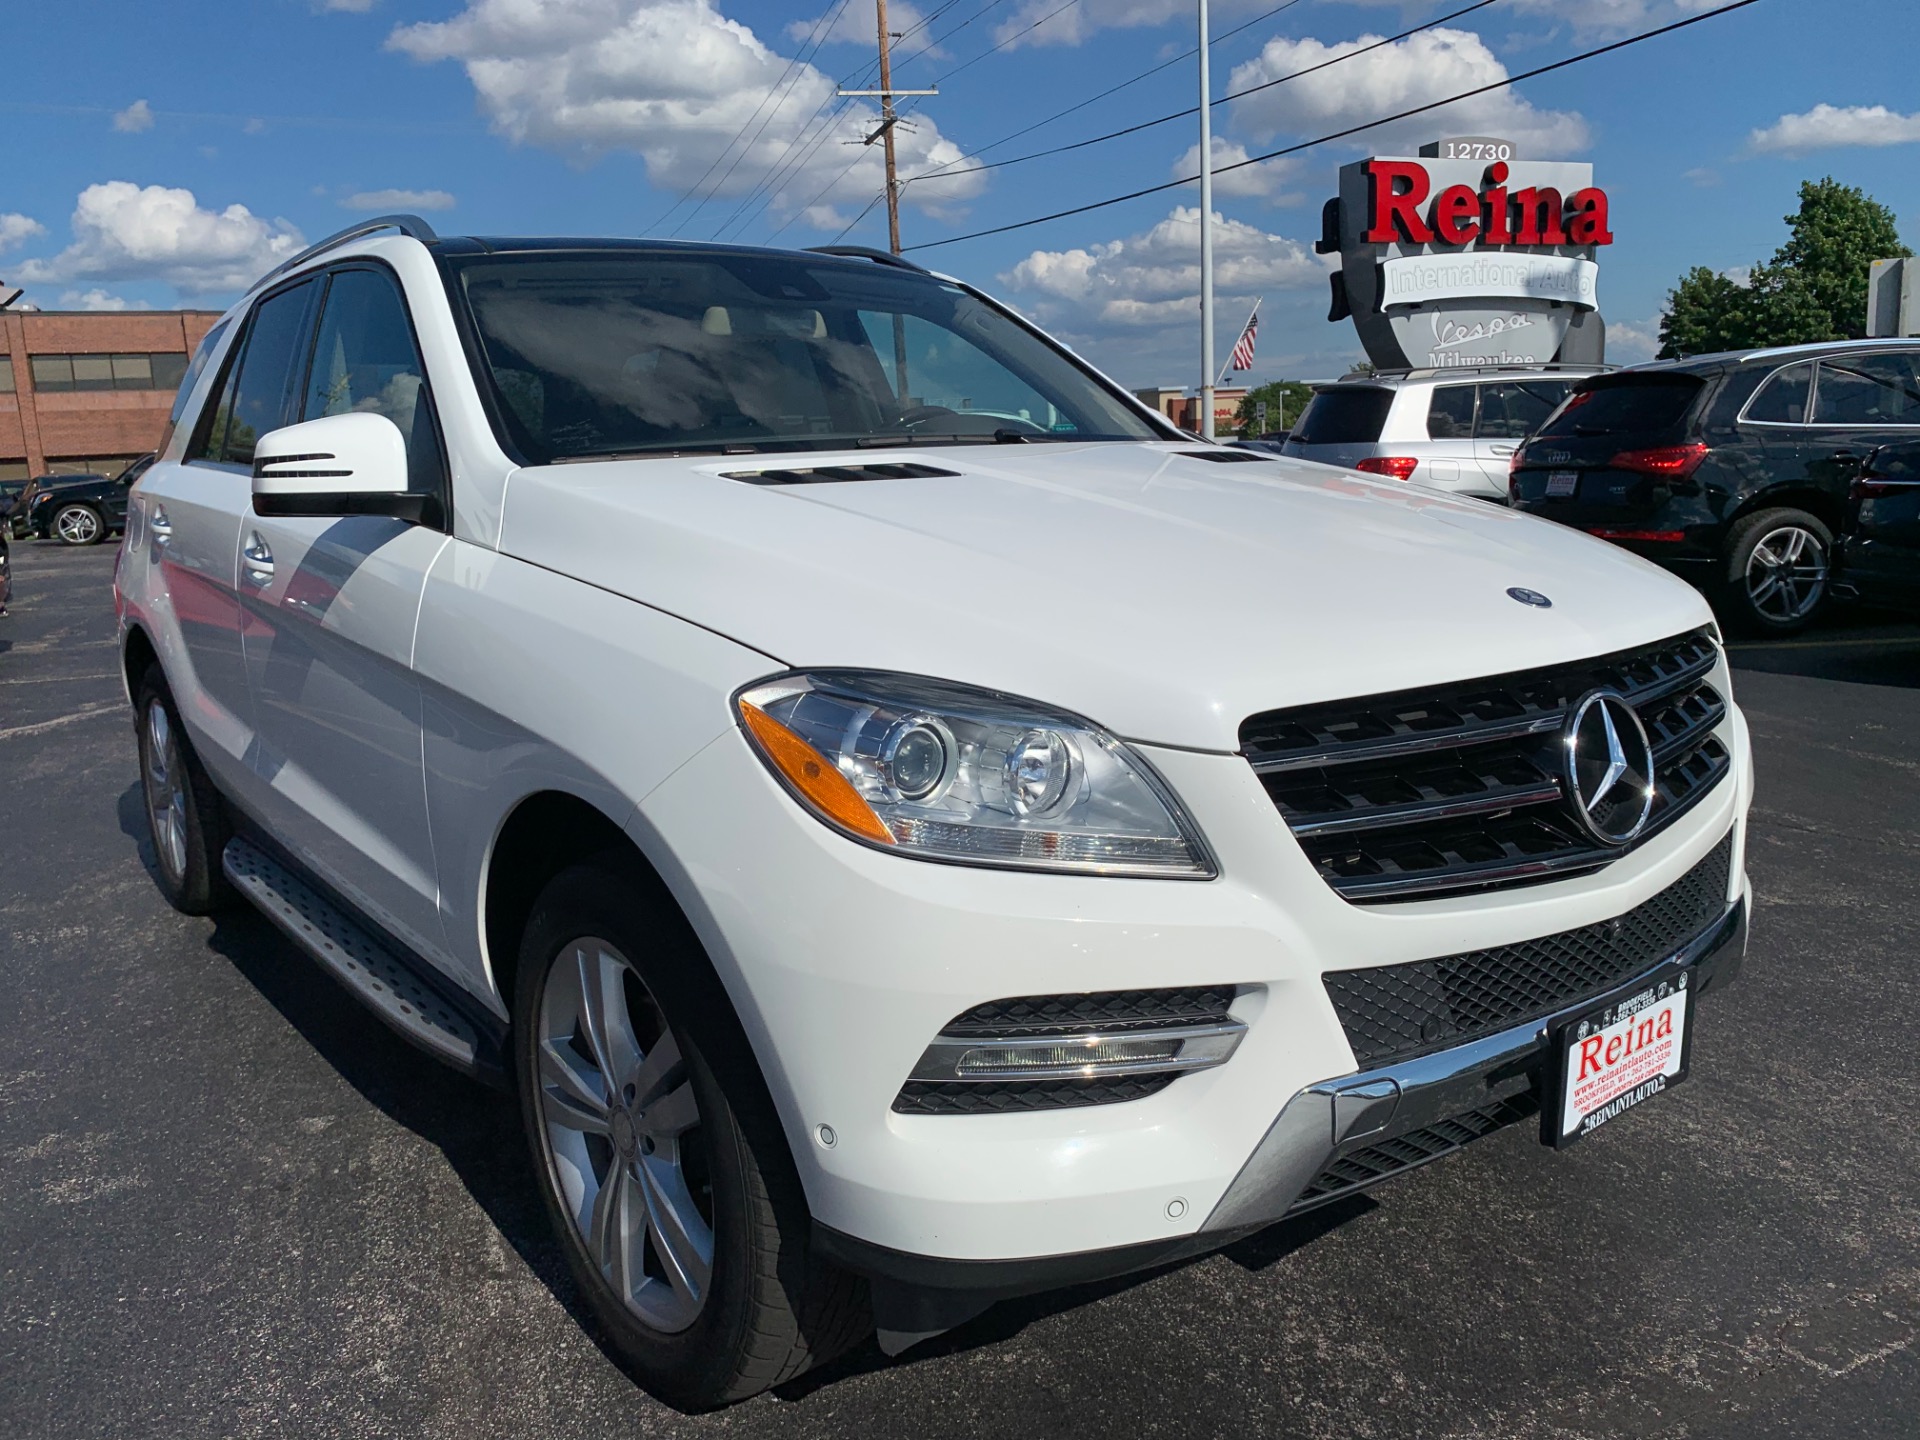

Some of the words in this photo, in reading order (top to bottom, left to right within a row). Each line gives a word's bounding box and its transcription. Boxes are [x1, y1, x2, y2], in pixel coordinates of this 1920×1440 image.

[1447, 142, 1510, 160] 12730
[1366, 160, 1613, 245] Reina
[1391, 258, 1535, 294] International
[1540, 263, 1591, 295] Auto
[1431, 305, 1535, 350] Vespa
[1428, 350, 1535, 367] Milwaukee
[1618, 988, 1654, 1013] BROOKFIELD
[1576, 1007, 1673, 1082] Reina
[1574, 1040, 1672, 1097] www.reinaintlauto.com
[1613, 1080, 1633, 1095] SPORTS
[1634, 1073, 1644, 1084] CAR
